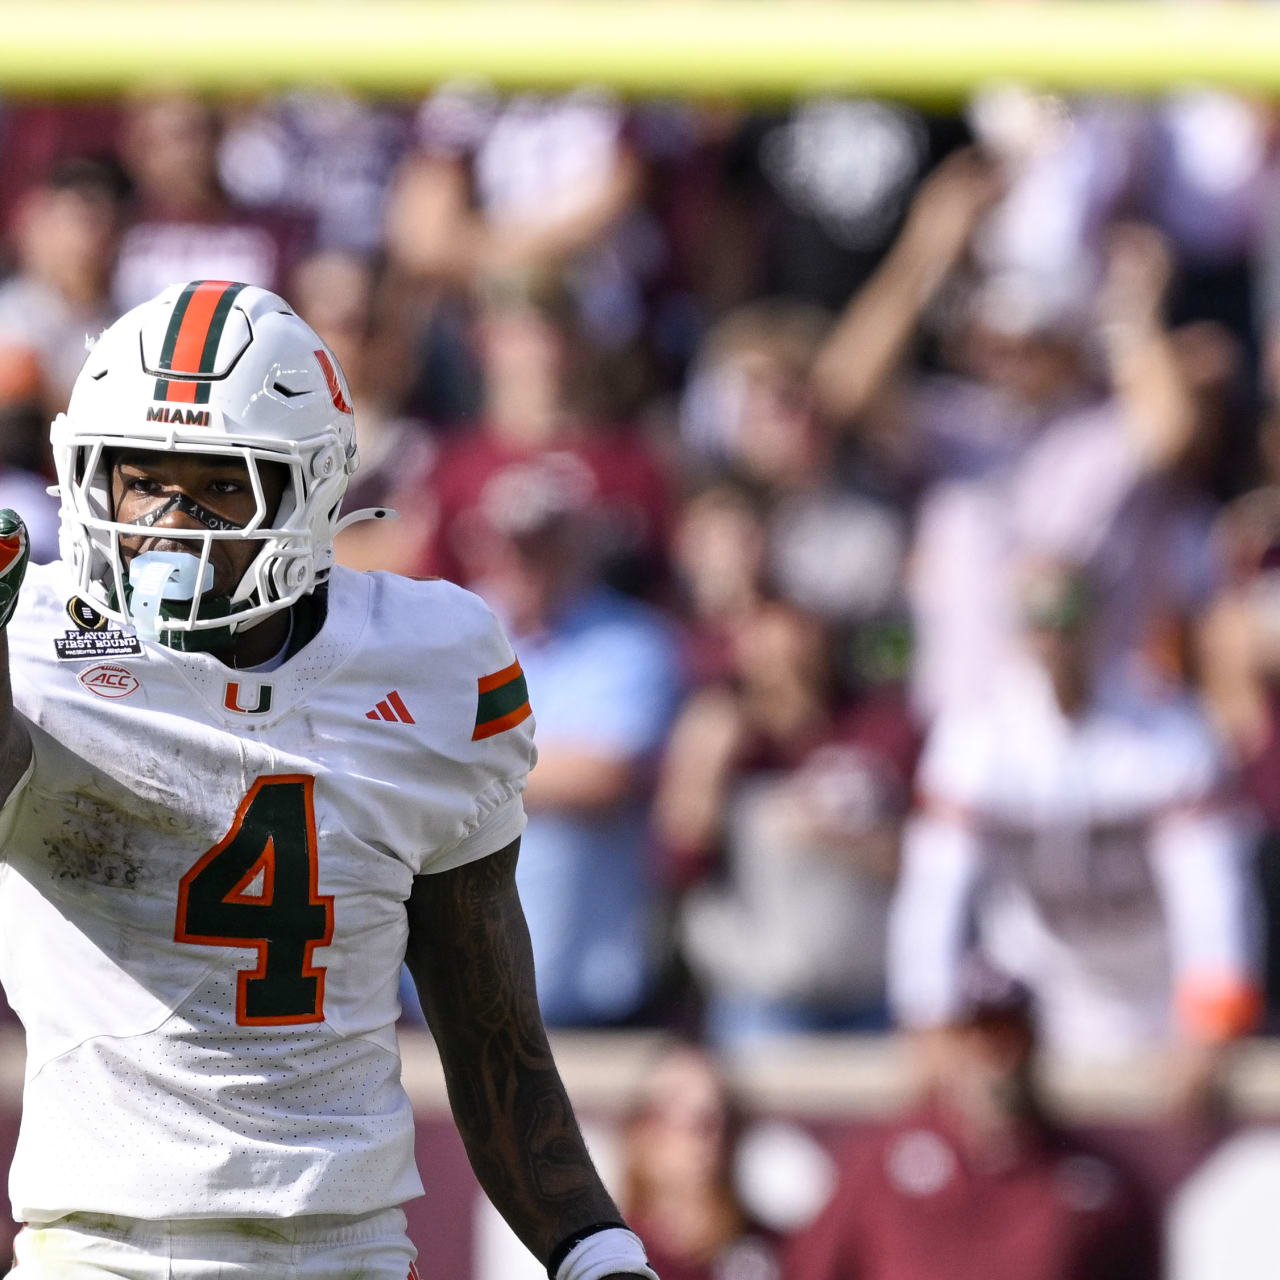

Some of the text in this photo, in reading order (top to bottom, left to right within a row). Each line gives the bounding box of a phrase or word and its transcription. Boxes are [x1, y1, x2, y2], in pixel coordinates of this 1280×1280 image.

[146, 406, 211, 427] MIAMI
[56, 637, 137, 649] FIRST ROUND
[67, 631, 121, 640] PLAYOFF
[90, 673, 131, 687] ACC
[224, 681, 273, 715] U
[174, 773, 335, 1027] 4
